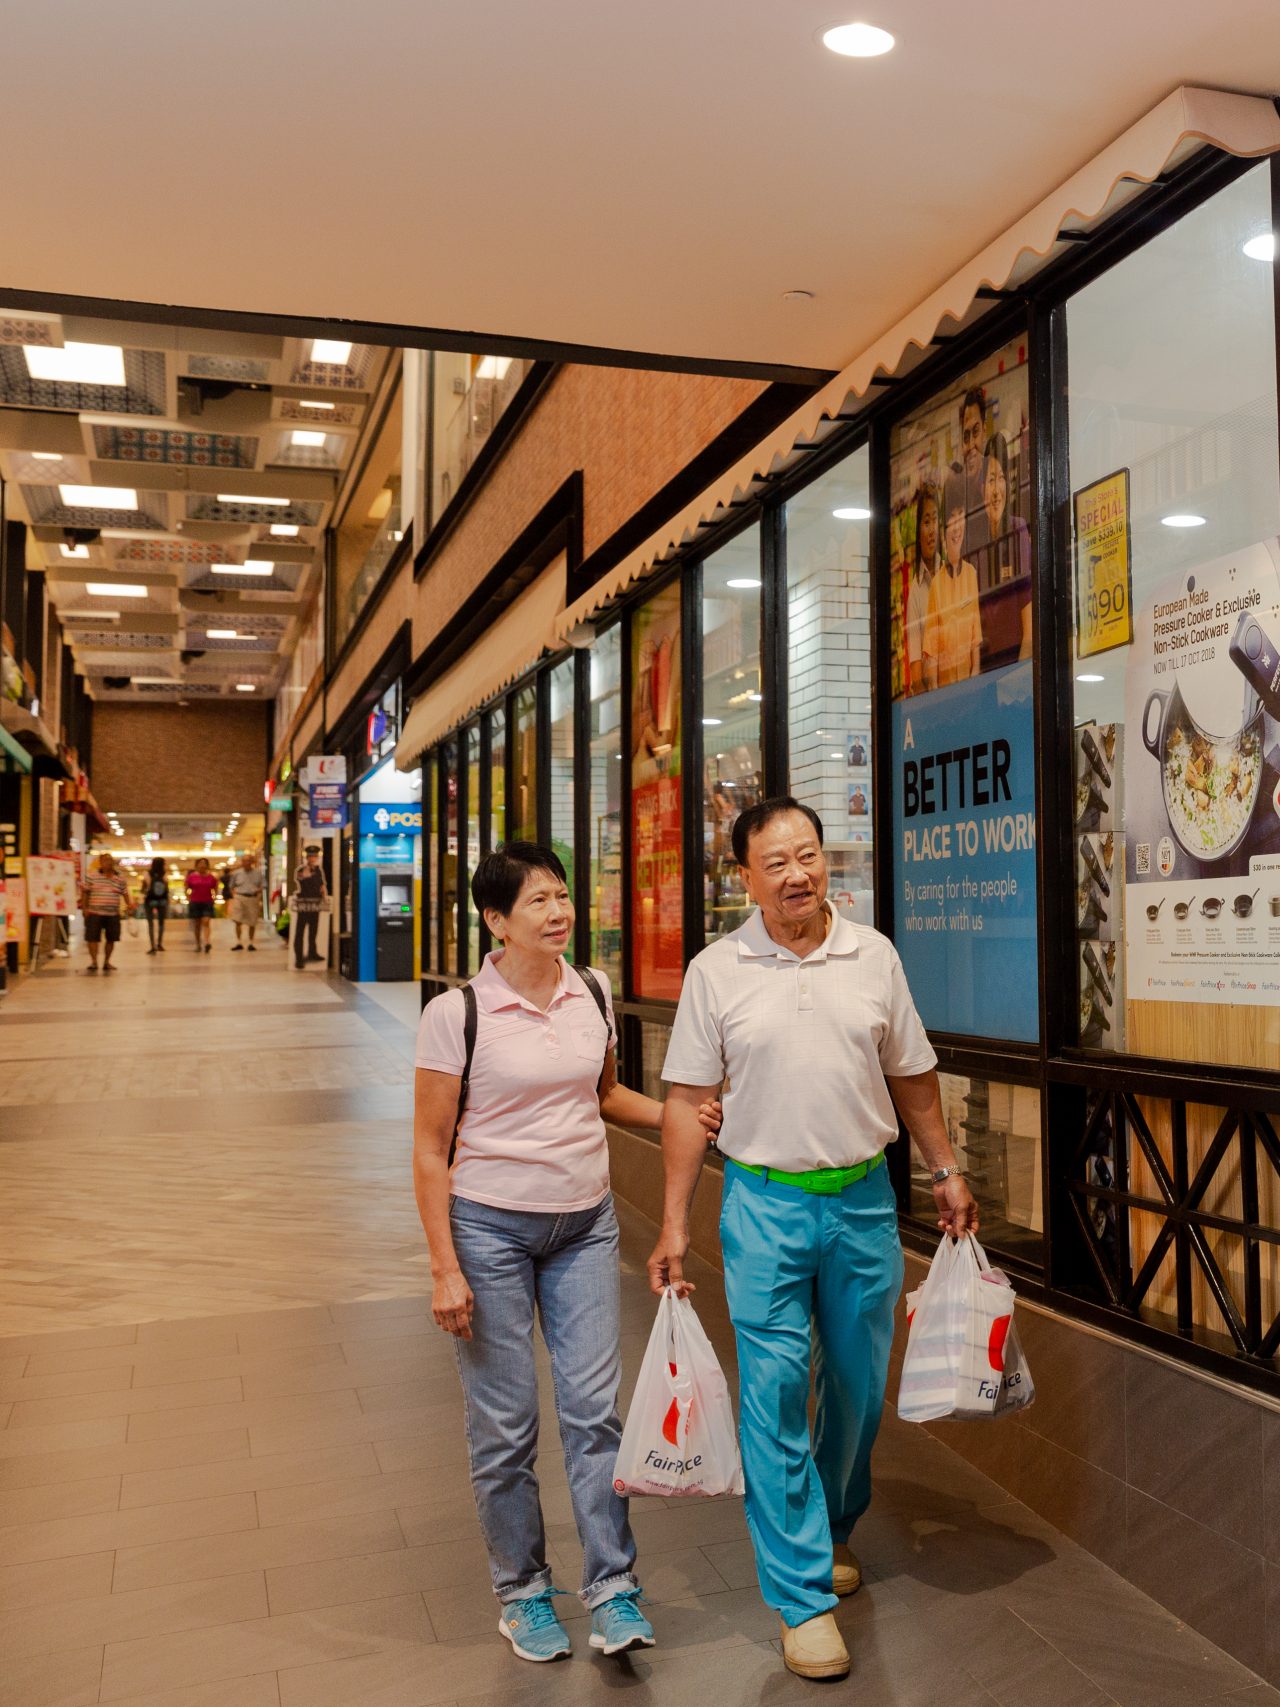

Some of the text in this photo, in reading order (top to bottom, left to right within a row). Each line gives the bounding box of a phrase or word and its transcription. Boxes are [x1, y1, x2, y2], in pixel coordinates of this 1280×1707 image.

[1080, 498, 1124, 532] SPECIAL
[1154, 589, 1209, 619] European Made
[1154, 592, 1261, 637] Pressure Cooker & Exclusive
[1154, 622, 1229, 656] Non-Stick Cookware
[1154, 646, 1216, 675] NOW TILL 17 OCT 2018
[904, 718, 915, 751] A
[904, 738, 1012, 818] BETTER
[904, 812, 1036, 863] PLACE TO WORK
[904, 871, 1018, 907] By caring for the people
[905, 910, 983, 932] who work with us
[978, 1372, 1022, 1400] Faiice
